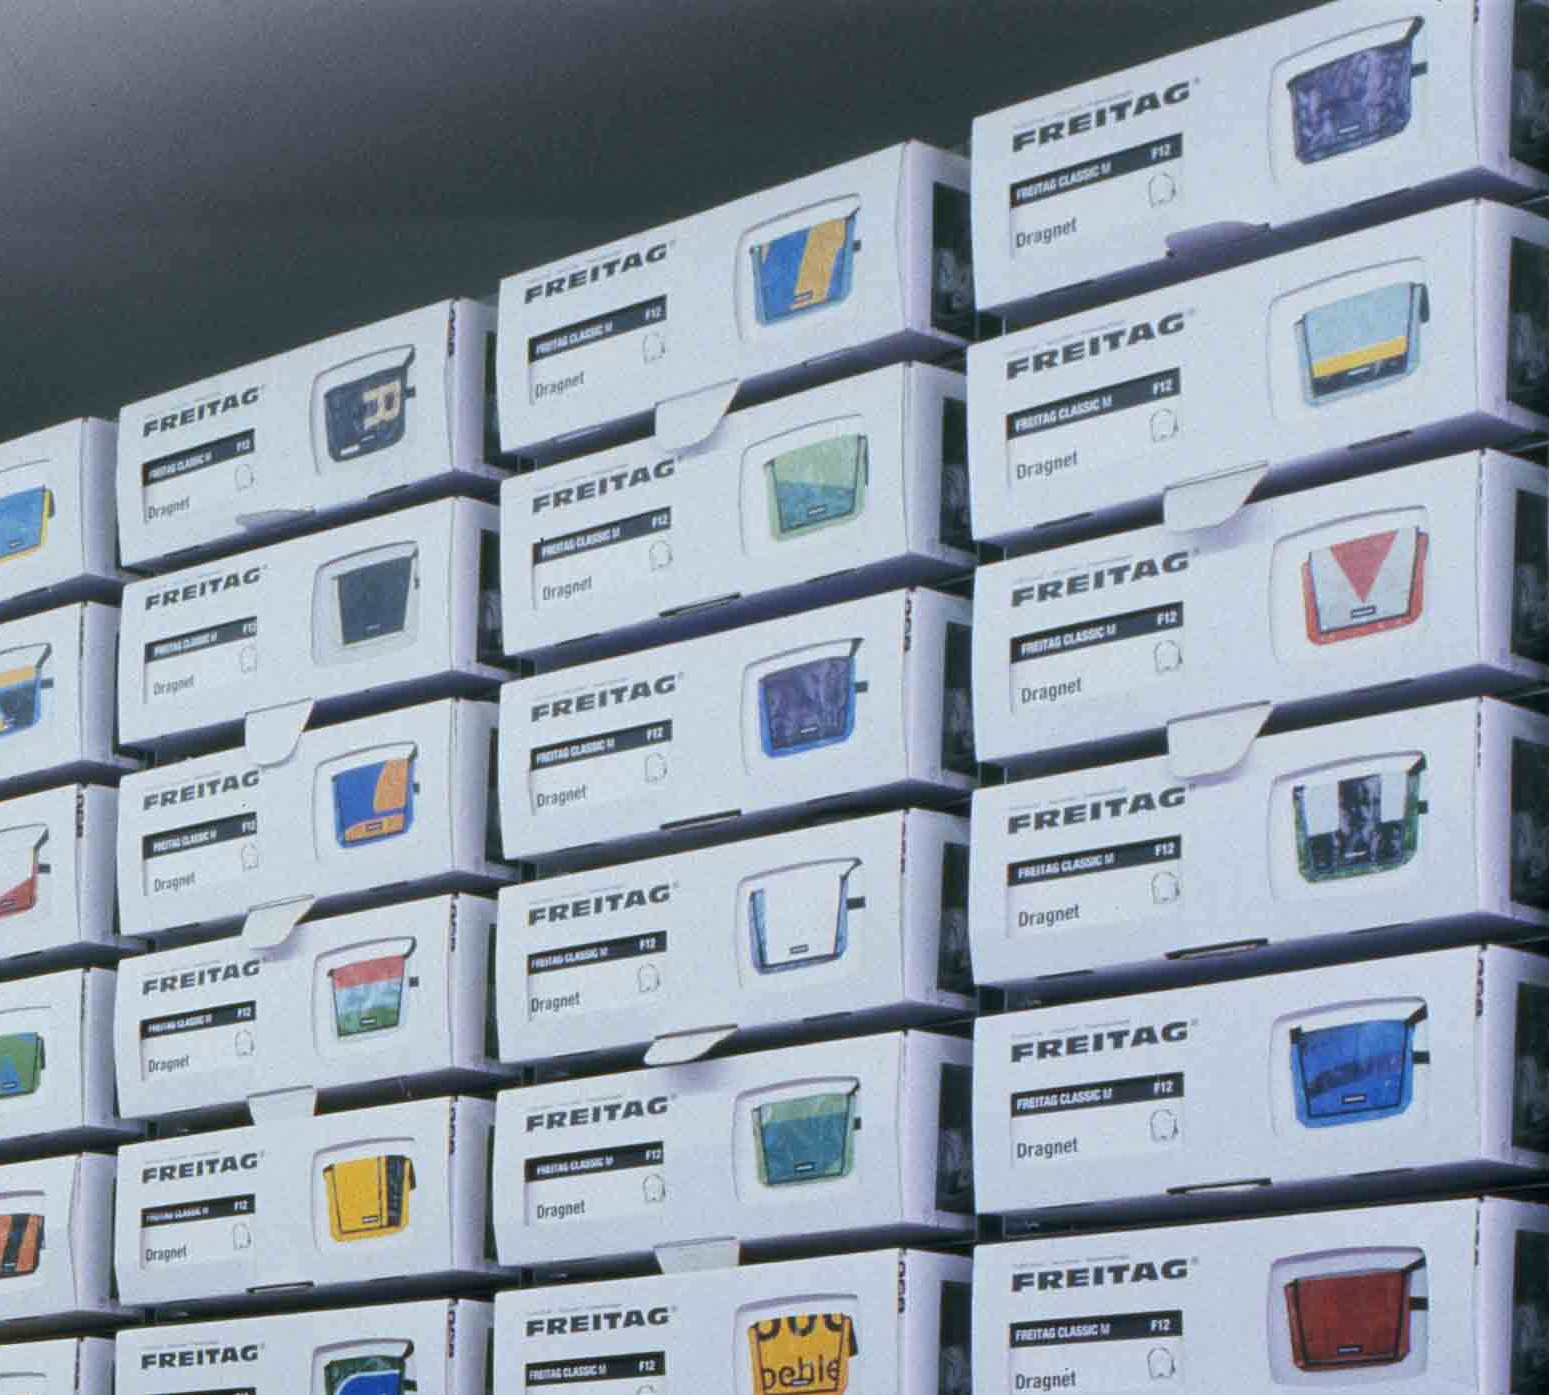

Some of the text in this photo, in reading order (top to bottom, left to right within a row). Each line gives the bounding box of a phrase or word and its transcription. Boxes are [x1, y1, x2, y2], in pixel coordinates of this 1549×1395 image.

[1013, 82, 1189, 152] FREITAG
[1016, 176, 1056, 200] FREITAG
[1058, 163, 1099, 188] CLASSIC
[1151, 142, 1171, 161] F12
[1015, 218, 1076, 248] Dragnet
[525, 244, 666, 303] FREITAG
[1007, 313, 1184, 379] FREITAG
[535, 371, 584, 399] Dragnet
[144, 388, 258, 437] FREITAG
[1015, 408, 1056, 431] FREITAG
[1058, 397, 1099, 420] CLASSIC
[1152, 378, 1172, 396] F12
[1016, 451, 1077, 480] Dragnet
[533, 459, 674, 513] FREITAG
[146, 568, 259, 610] FREITAG
[543, 576, 592, 600] Dragnet
[1012, 551, 1188, 607] FREITAG
[532, 675, 675, 722] FREITAG
[1022, 678, 1081, 704] Dragnet
[535, 785, 586, 815] Dragnet
[1009, 787, 1185, 834] FREITAG
[1017, 860, 1059, 879] FREITAG
[1061, 853, 1102, 872] CLASSIC
[1154, 841, 1174, 856] F12
[529, 885, 669, 925] FREITAG
[1018, 904, 1079, 927] Dragnet
[1012, 1022, 1187, 1062] FREITAG
[1017, 1094, 1057, 1110] FREITAG
[1059, 1089, 1101, 1105] CLASSIC
[1153, 1080, 1173, 1095] F12
[527, 1097, 667, 1131] FREITAG
[1017, 1138, 1077, 1159] Dragnet
[143, 1153, 257, 1183] FREITAG
[537, 1200, 585, 1219] Dragnet
[1012, 1260, 1187, 1292] FREITAG
[527, 1308, 668, 1336] FREITAG
[1015, 1326, 1055, 1341] FREITAG
[1057, 1323, 1098, 1338] CLASSIC
[1150, 1318, 1170, 1331] F12
[142, 1345, 257, 1369] FREITAG
[1015, 1371, 1075, 1391] Dragnet
